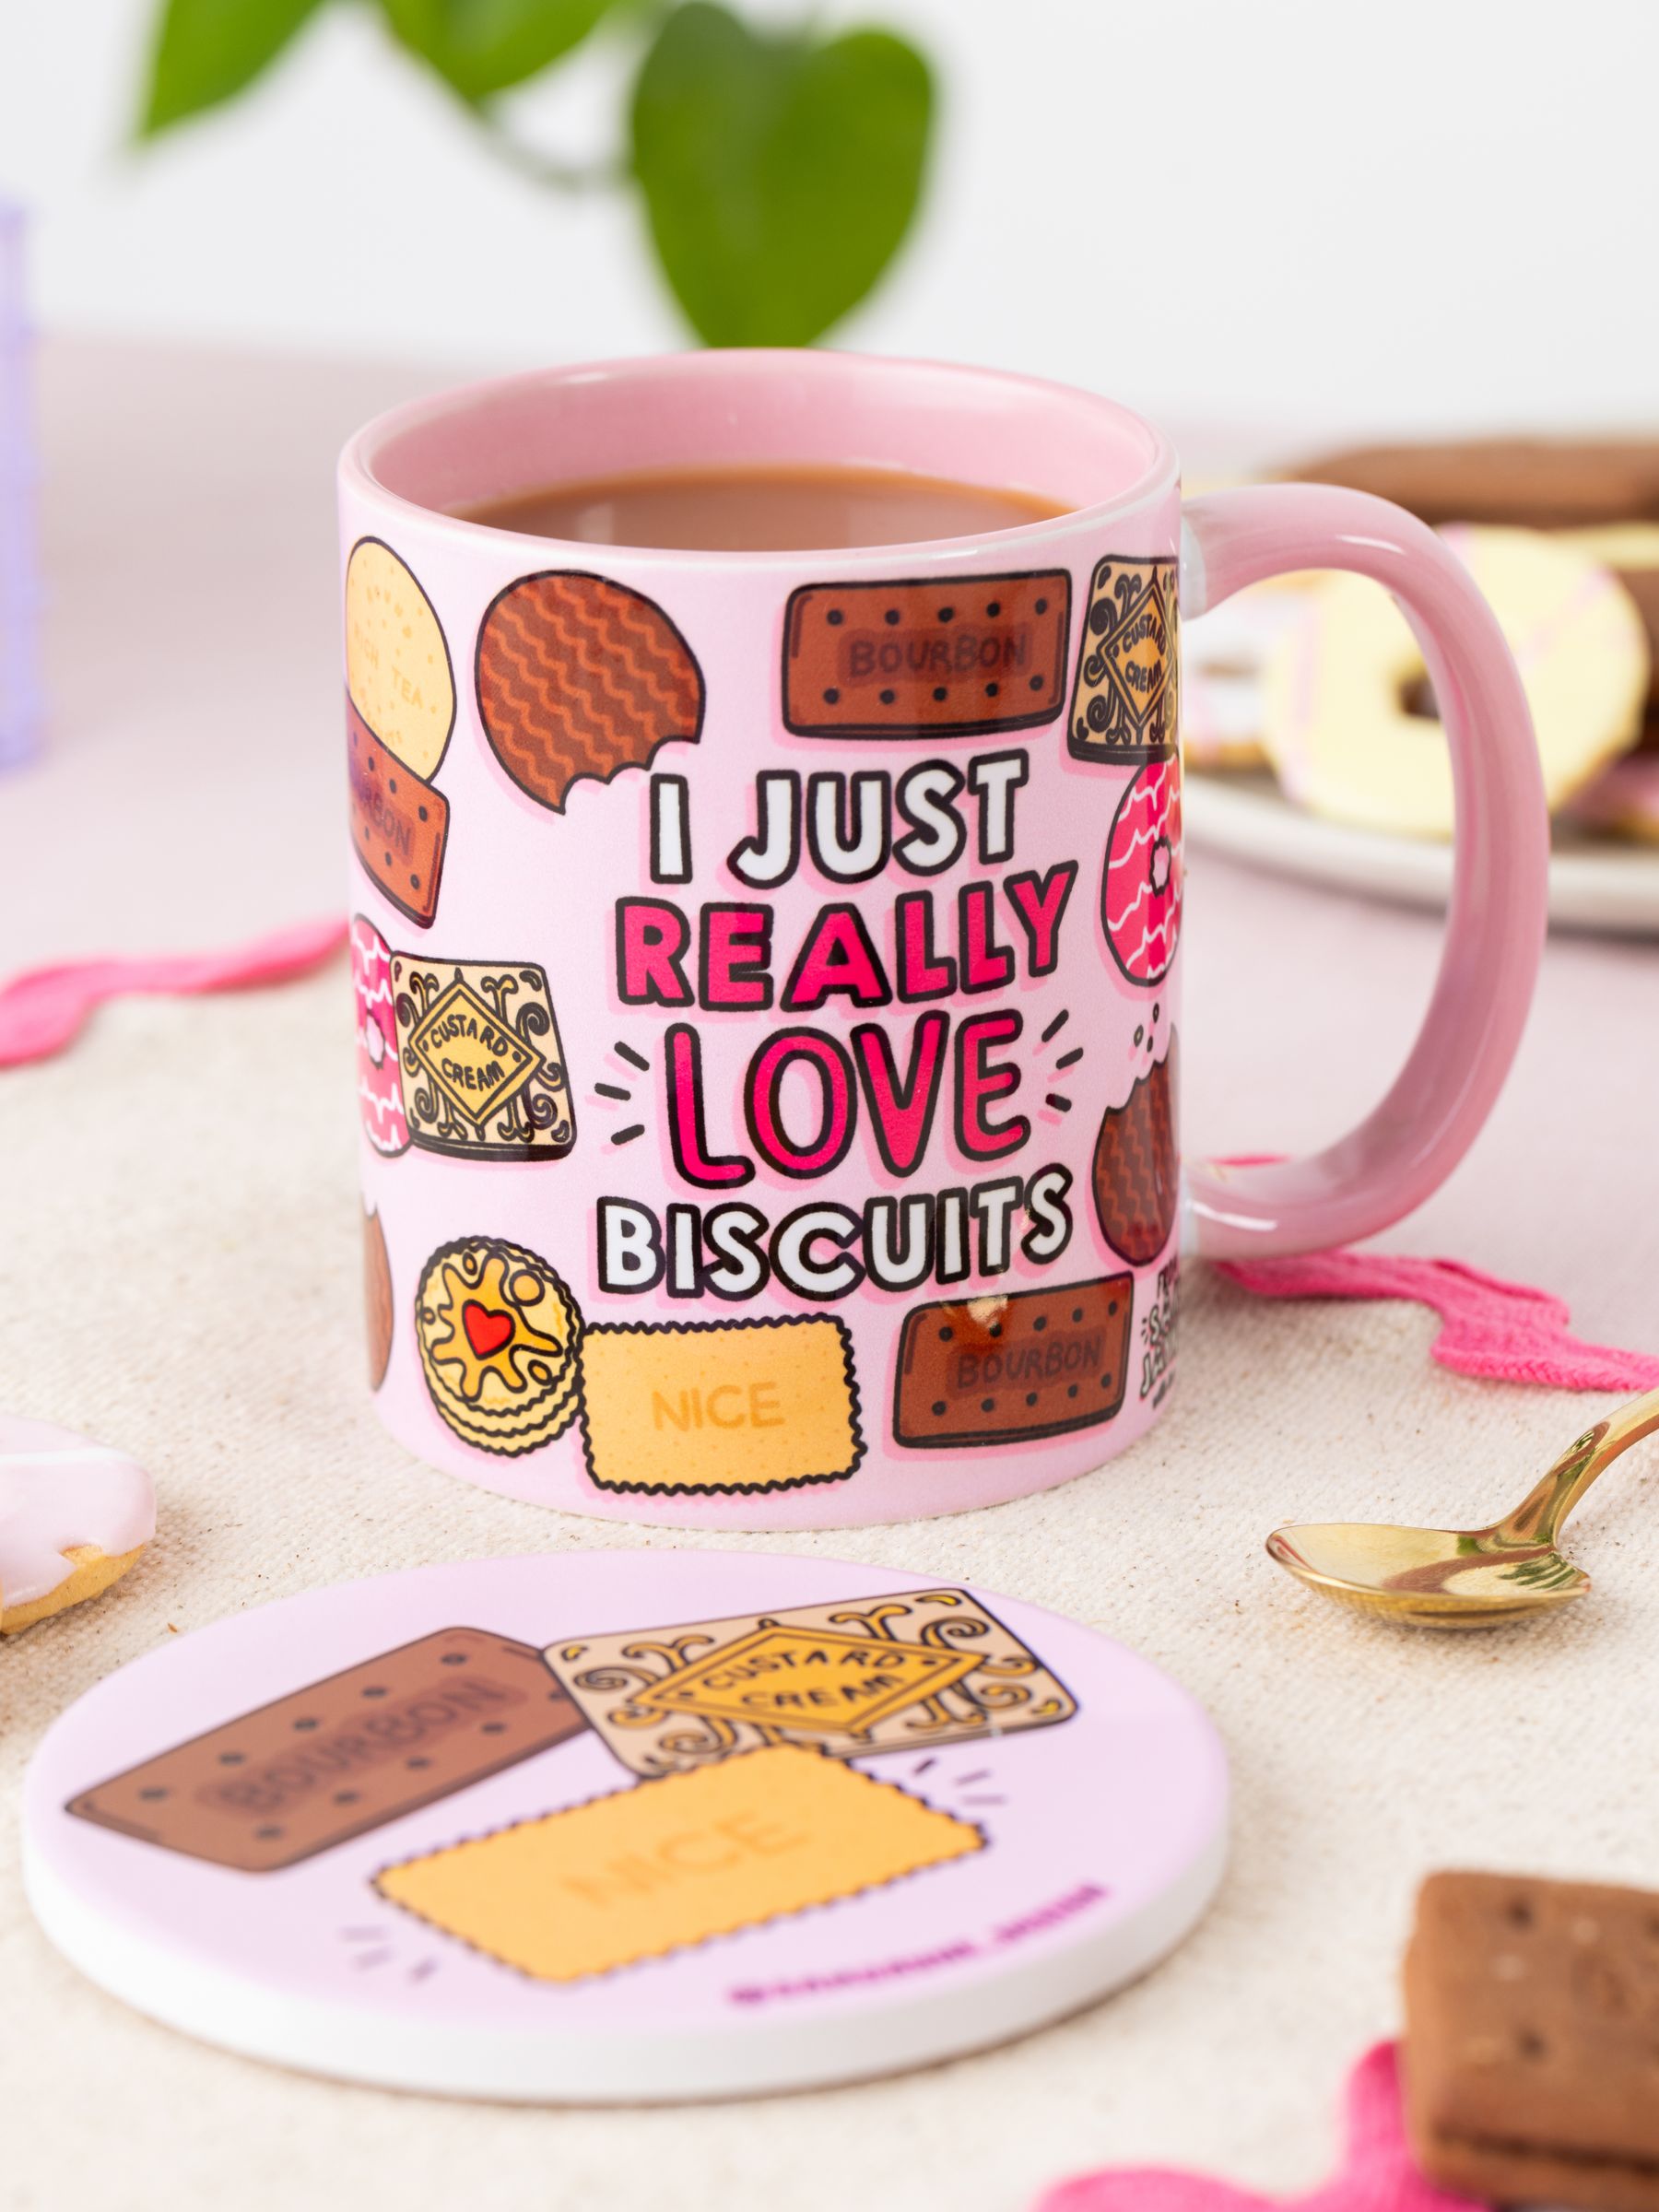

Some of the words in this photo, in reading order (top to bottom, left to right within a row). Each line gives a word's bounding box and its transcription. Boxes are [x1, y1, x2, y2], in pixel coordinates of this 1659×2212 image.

[848, 633, 1026, 677] BOURBON
[1124, 659, 1162, 693] CREAM
[392, 665, 424, 710] TEA
[650, 775, 693, 884] I
[726, 748, 1030, 890] JUST
[615, 860, 1079, 1012] REALLY
[430, 1014, 509, 1057] CUSTARD
[441, 1057, 505, 1091] CREAM
[664, 1008, 1030, 1190] LOVE
[597, 1162, 1074, 1301] BISCUITS
[957, 1335, 1103, 1390] BOURBON
[651, 1382, 786, 1431] NICE
[701, 1650, 906, 1690] CUSTARD
[741, 1675, 904, 1709] CREAM
[215, 1680, 508, 1816] BOURBON
[560, 1809, 814, 1911] NICE
